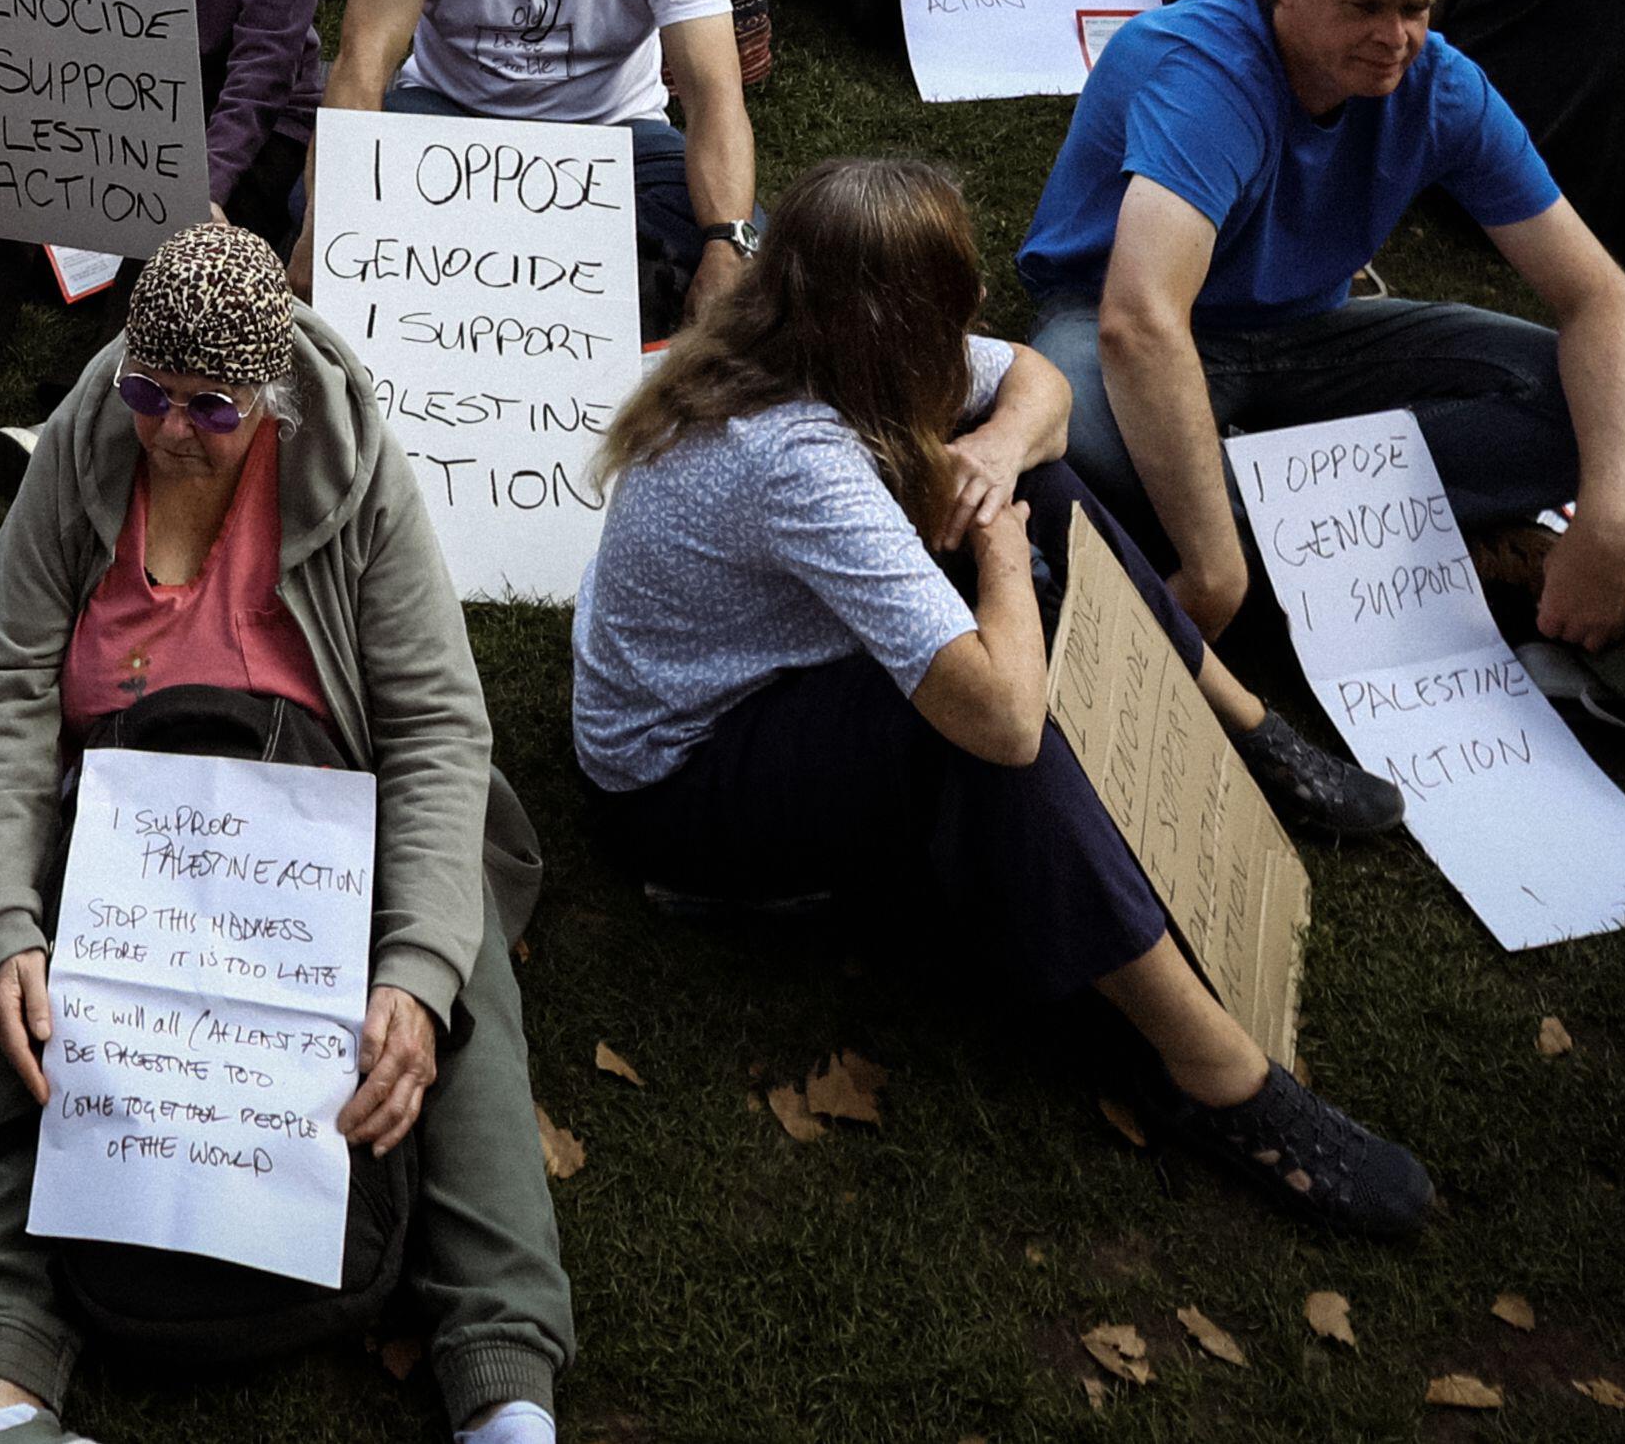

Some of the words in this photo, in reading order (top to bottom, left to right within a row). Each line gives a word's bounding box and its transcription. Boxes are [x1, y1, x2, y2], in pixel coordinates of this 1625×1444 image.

[415, 143, 622, 211] OPPOSE
[325, 231, 605, 294] GENOCIDE
[399, 312, 613, 358] SUPPORT
[1287, 434, 1410, 495] OPPOSE
[1274, 491, 1453, 567] GENOCIDE
[1347, 555, 1478, 621] SUPPORT
[1339, 660, 1528, 724] PALESTINE
[88, 900, 147, 929] STOP
